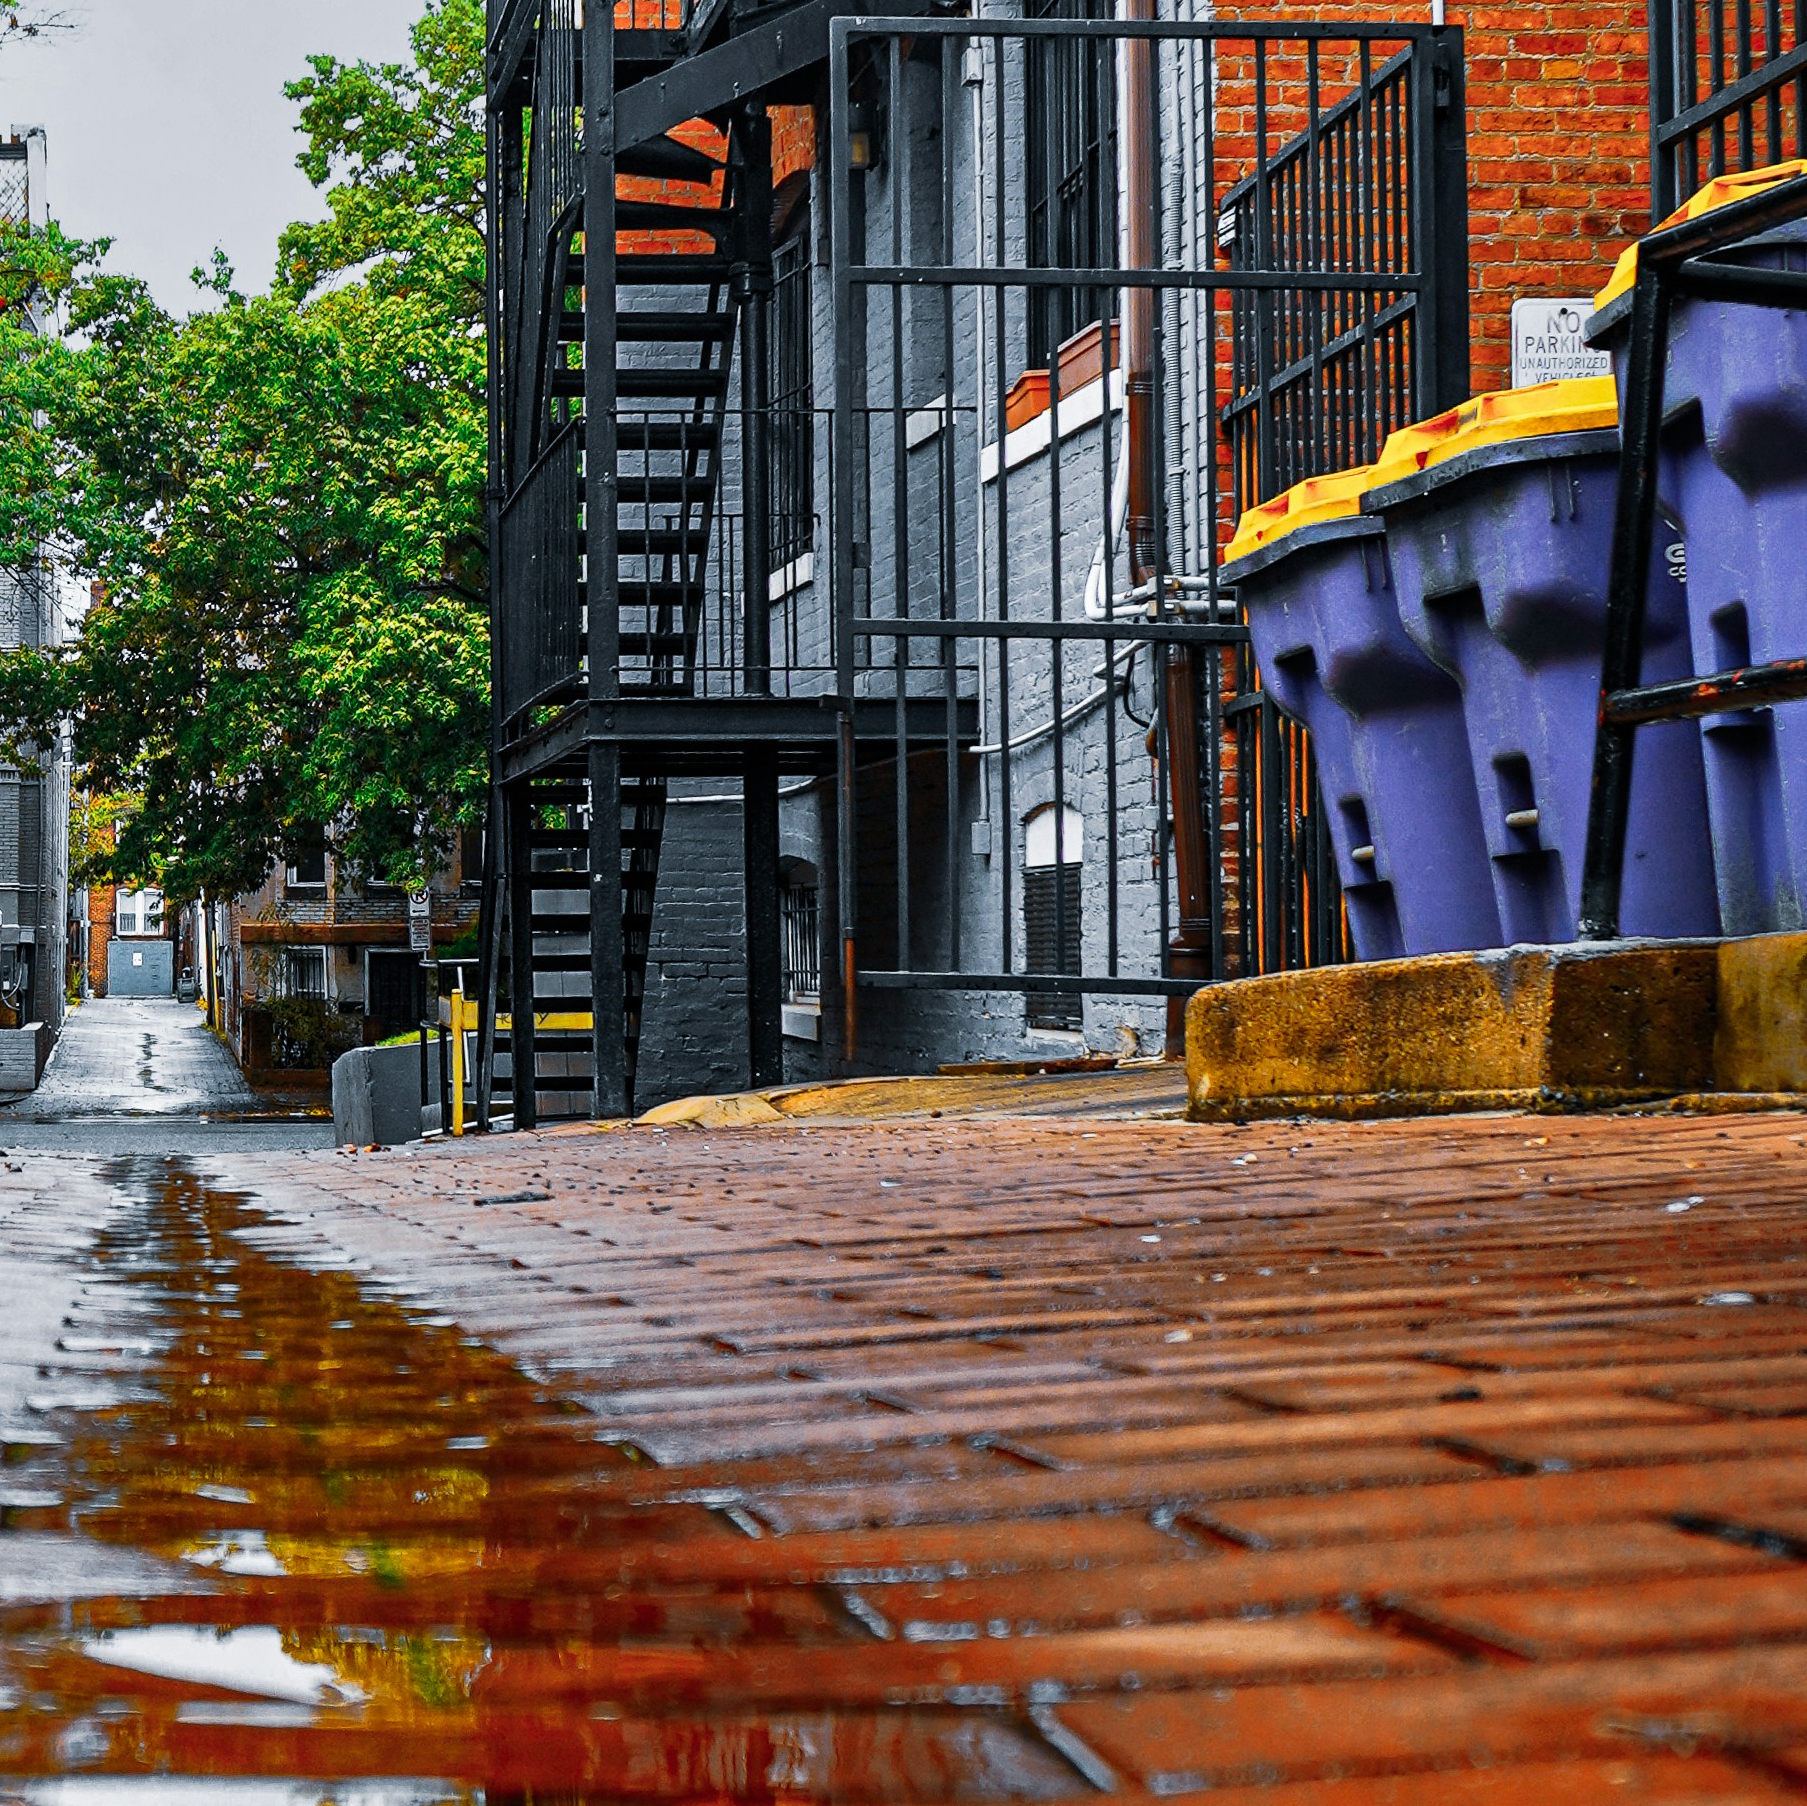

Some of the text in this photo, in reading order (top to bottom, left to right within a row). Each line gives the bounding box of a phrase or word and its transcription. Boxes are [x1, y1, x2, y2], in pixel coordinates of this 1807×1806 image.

[1547, 310, 1581, 334] NO
[1525, 336, 1601, 354] PARKIN
[1520, 357, 1608, 370] UNAUTHORIZED
